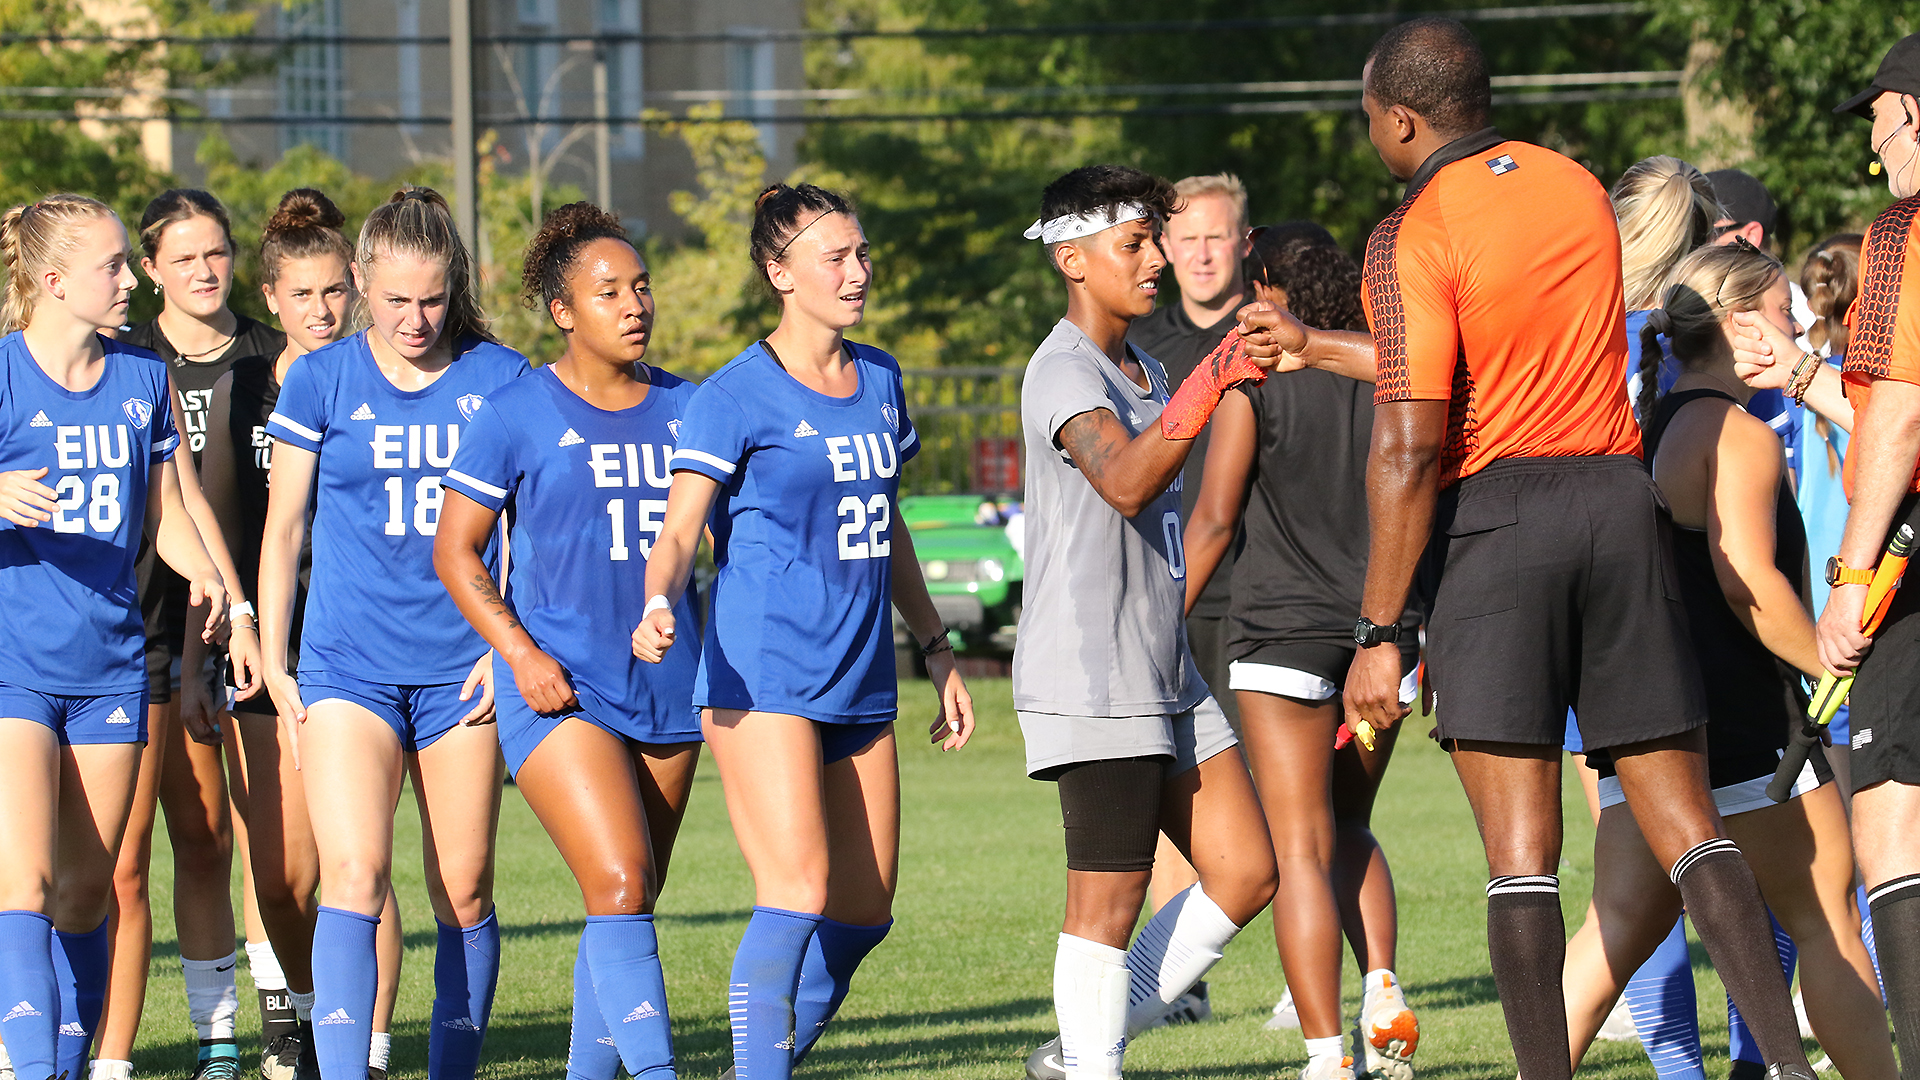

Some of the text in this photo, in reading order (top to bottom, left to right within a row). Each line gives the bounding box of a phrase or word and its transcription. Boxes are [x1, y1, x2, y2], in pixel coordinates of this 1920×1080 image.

[53, 424, 130, 470] EIU
[368, 423, 460, 469] EIU
[586, 443, 675, 489] EIU
[824, 432, 897, 482] EIU
[52, 473, 121, 533] 28
[384, 475, 445, 536] 18
[837, 493, 891, 561] 22
[606, 498, 669, 561] 15
[318, 1017, 356, 1026] adidas
[622, 1010, 660, 1024] adidas
